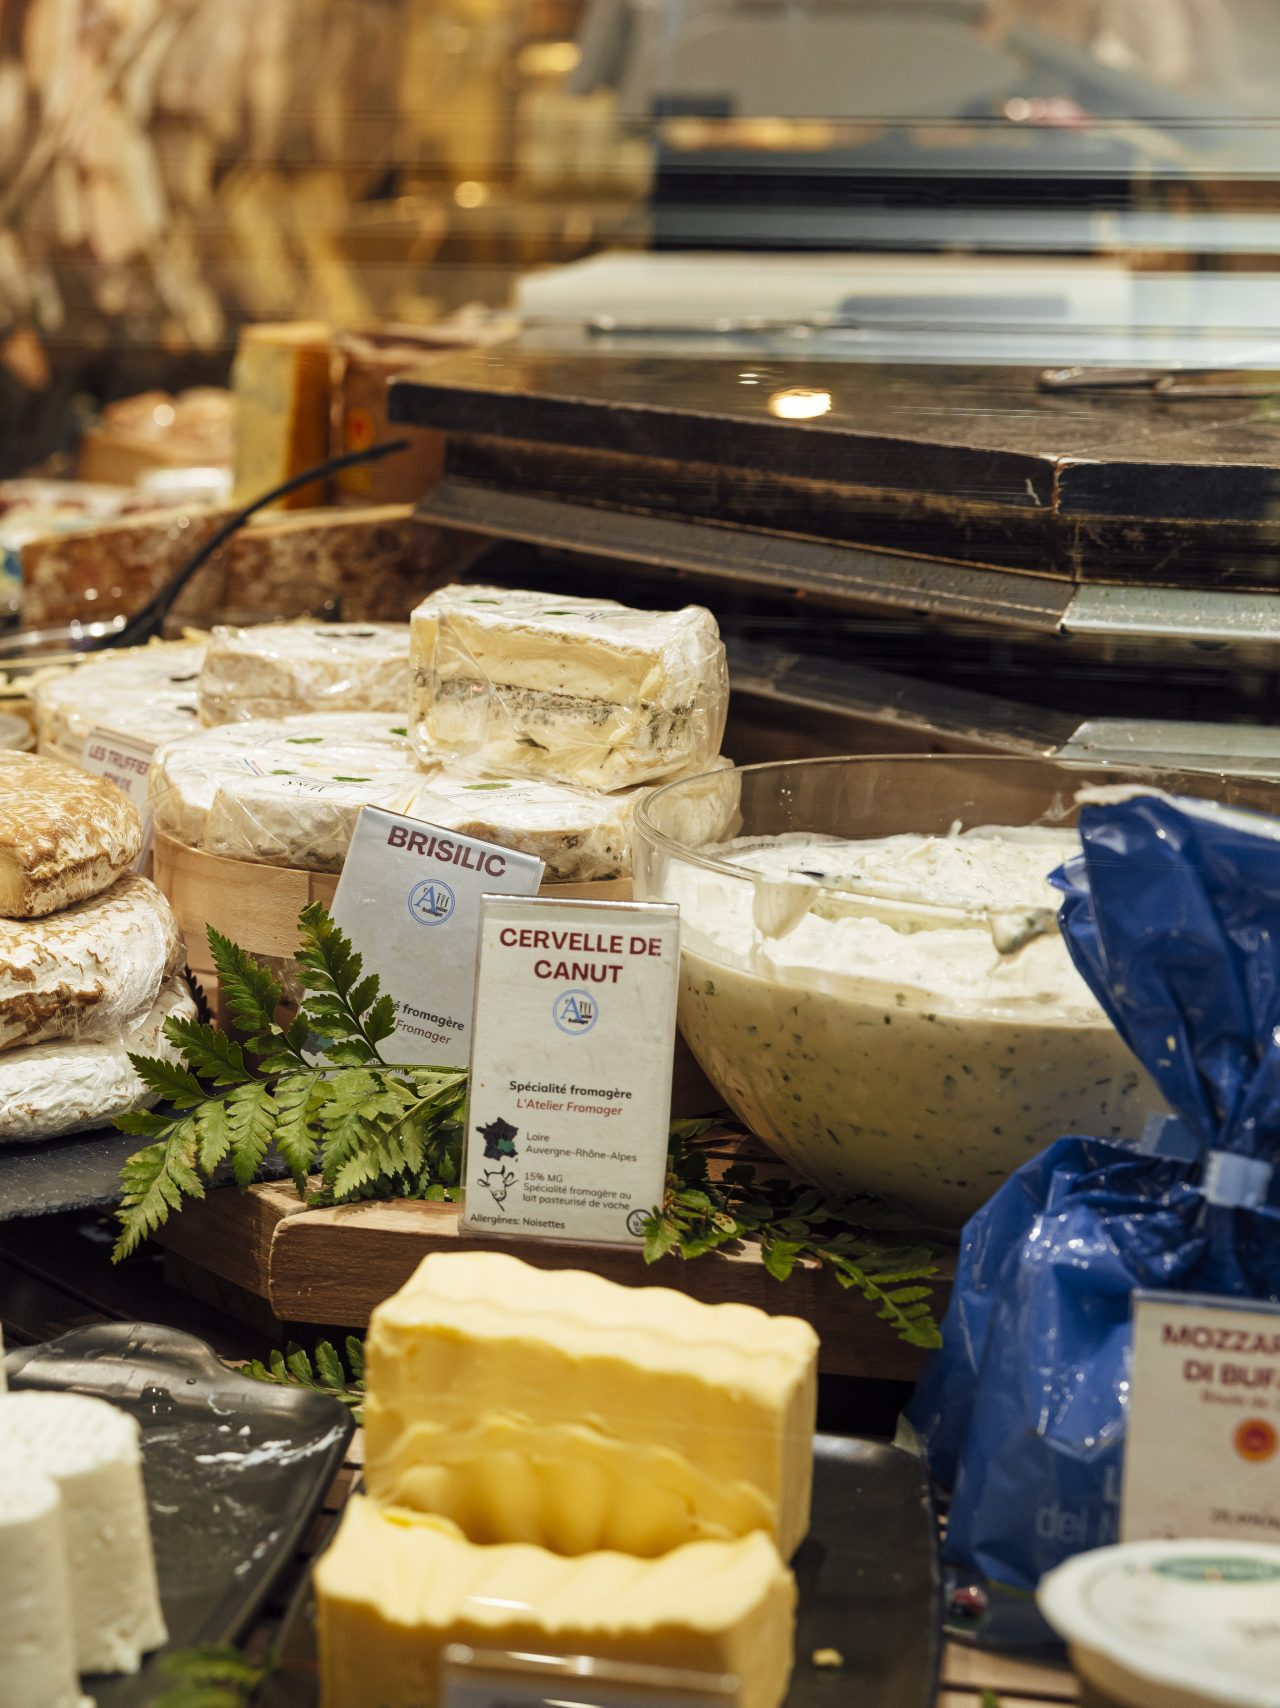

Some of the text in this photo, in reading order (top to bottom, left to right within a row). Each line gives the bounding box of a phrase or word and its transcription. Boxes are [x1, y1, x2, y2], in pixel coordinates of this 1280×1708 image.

[387, 825, 507, 878] BRISILIC
[499, 927, 662, 957] CERVELLE DE
[533, 959, 623, 984] CANUT
[402, 1004, 465, 1031] fromagère
[396, 1019, 452, 1045] Fromager
[509, 1080, 632, 1100] Spécialité fromagère
[517, 1098, 623, 1117] L'Atelier Fromager
[526, 1132, 550, 1142] Loire
[525, 1145, 637, 1162] Auvergne-Rhône-Alpes
[524, 1171, 563, 1183] 15% MG
[523, 1183, 632, 1200] Spécialité fromagère au
[522, 1193, 630, 1211] lait pasteurisé de vache
[470, 1213, 566, 1229] Allergènes: Noisettes
[1183, 1359, 1280, 1388] DI BUF
